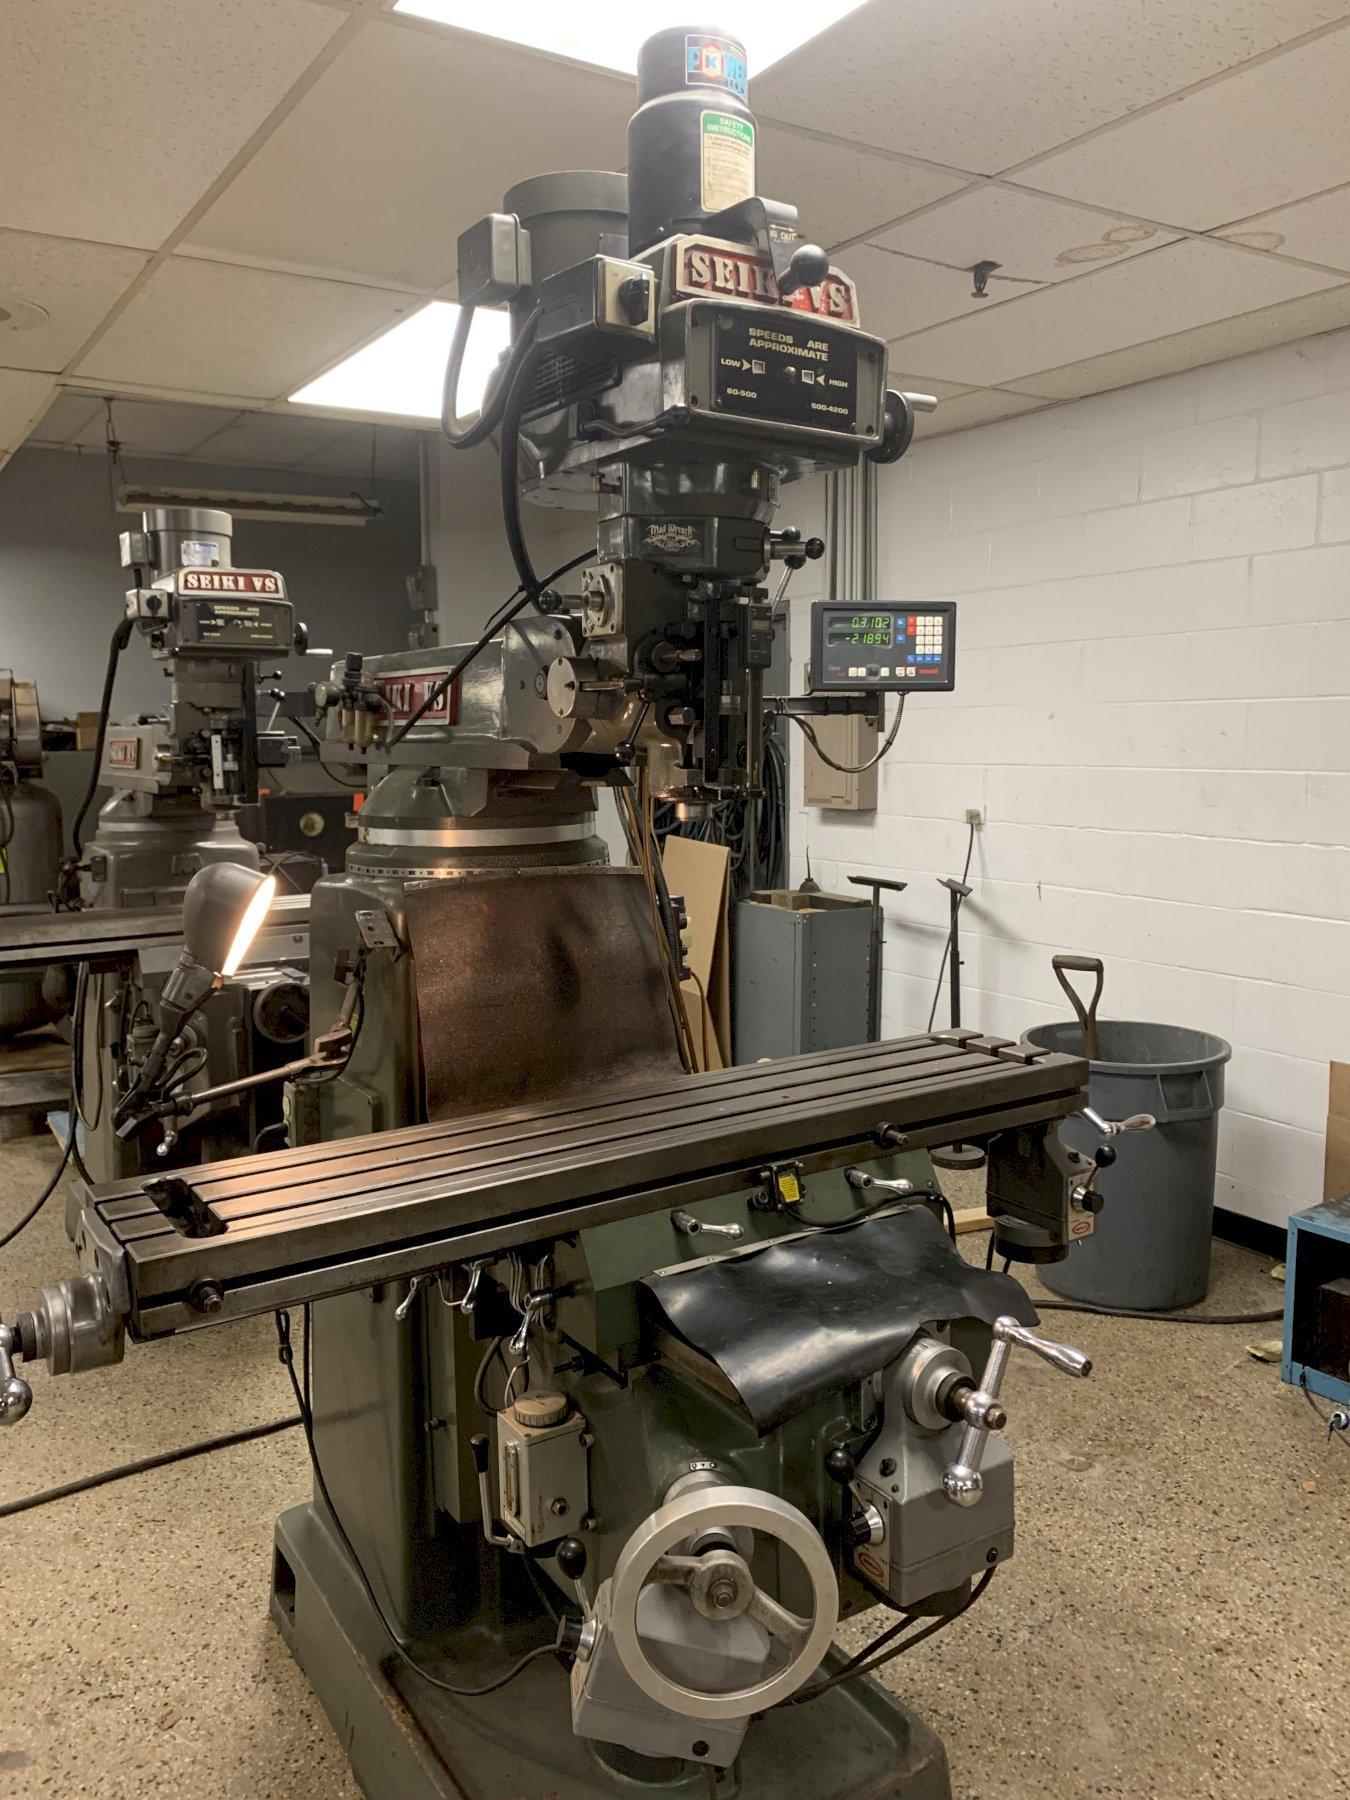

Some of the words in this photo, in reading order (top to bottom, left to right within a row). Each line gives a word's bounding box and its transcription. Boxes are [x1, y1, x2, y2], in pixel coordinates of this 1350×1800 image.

[780, 231, 797, 241] OUT
[748, 327, 794, 344] SPEEDS
[807, 339, 829, 352] ARE
[748, 338, 829, 362] APPROXIMATE
[720, 358, 741, 368] LOW
[828, 378, 848, 388] HIGH
[726, 387, 757, 399] 60-500
[186, 573, 246, 591] SEIKI
[252, 577, 277, 592] VS
